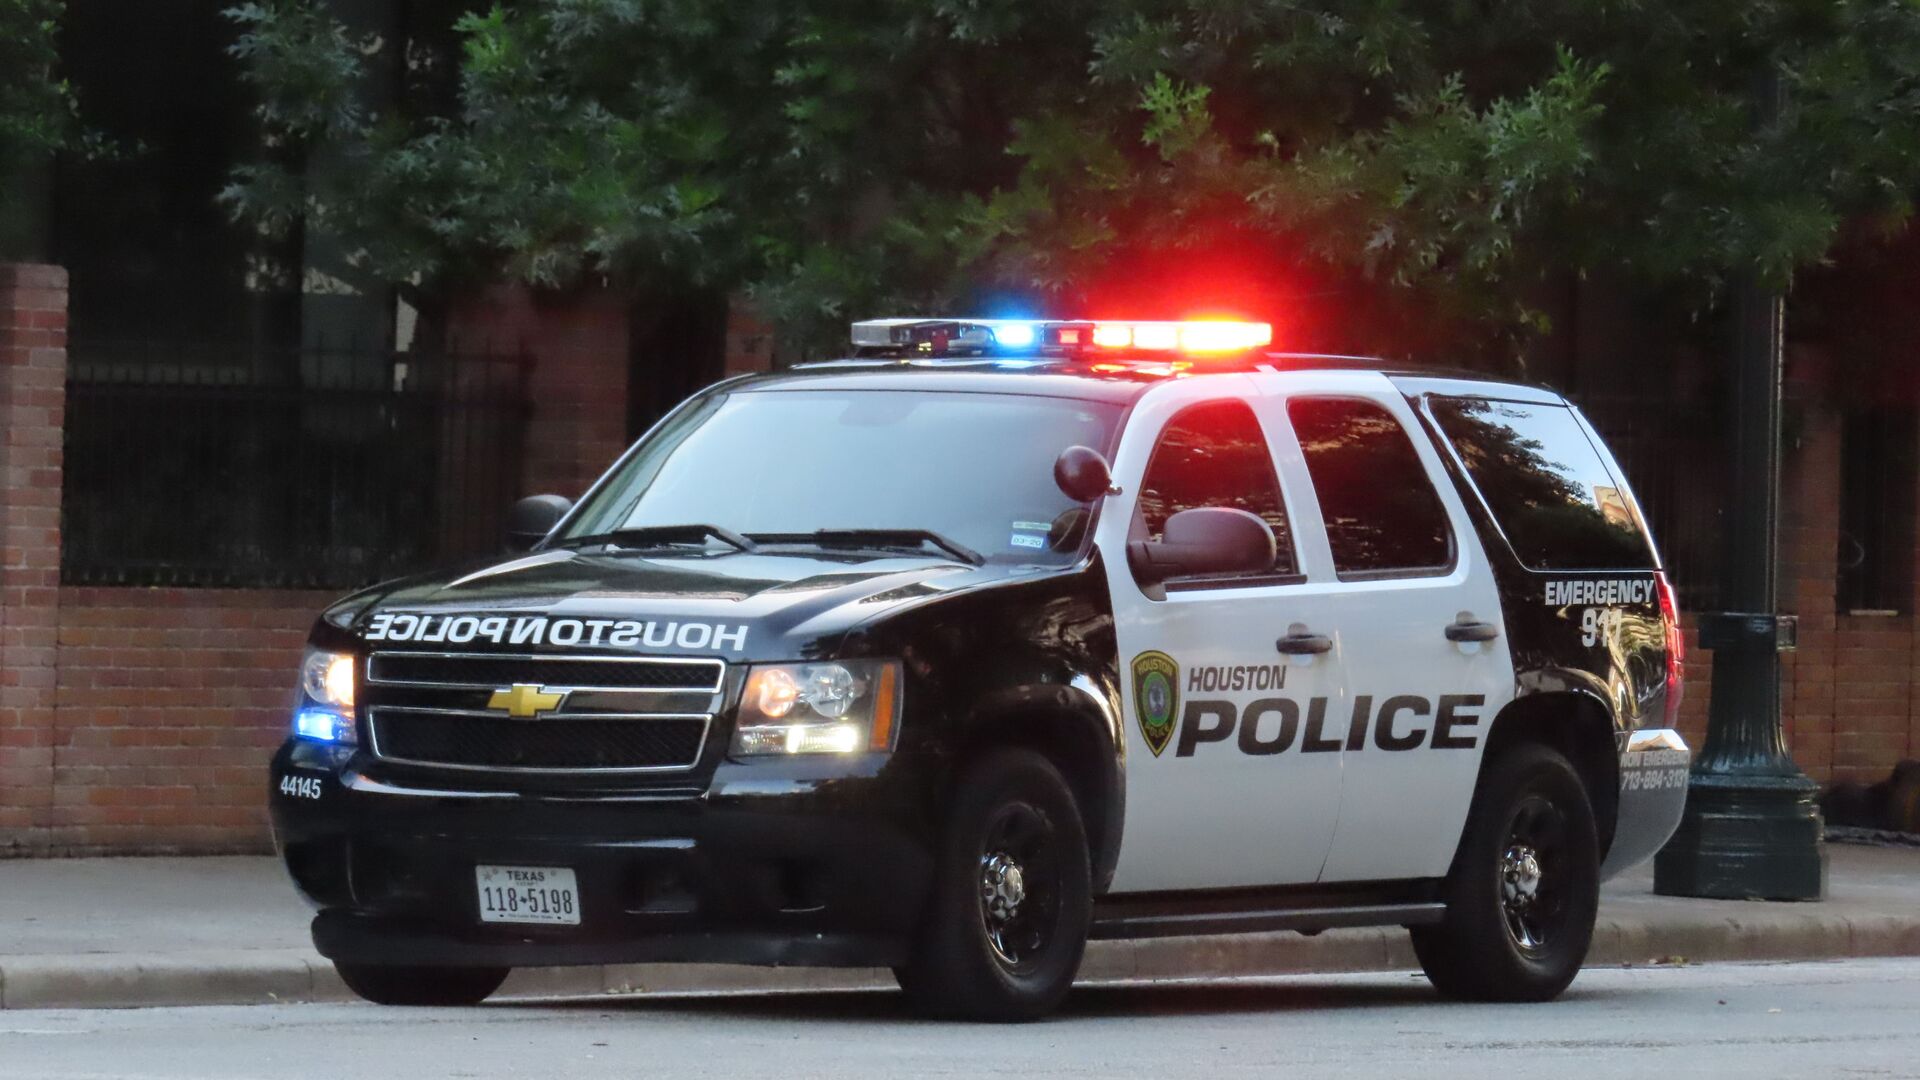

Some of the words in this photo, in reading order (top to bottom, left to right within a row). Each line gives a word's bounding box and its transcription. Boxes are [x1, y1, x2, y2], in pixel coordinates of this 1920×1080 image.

[1545, 580, 1655, 605] EMERGENCY
[1581, 608, 1623, 647] 911
[1136, 658, 1174, 676] HOUSTON
[1187, 665, 1288, 692] HOUSTON
[1175, 694, 1486, 757] POLICE
[280, 775, 322, 799] 44145
[506, 870, 546, 882] TEXAS
